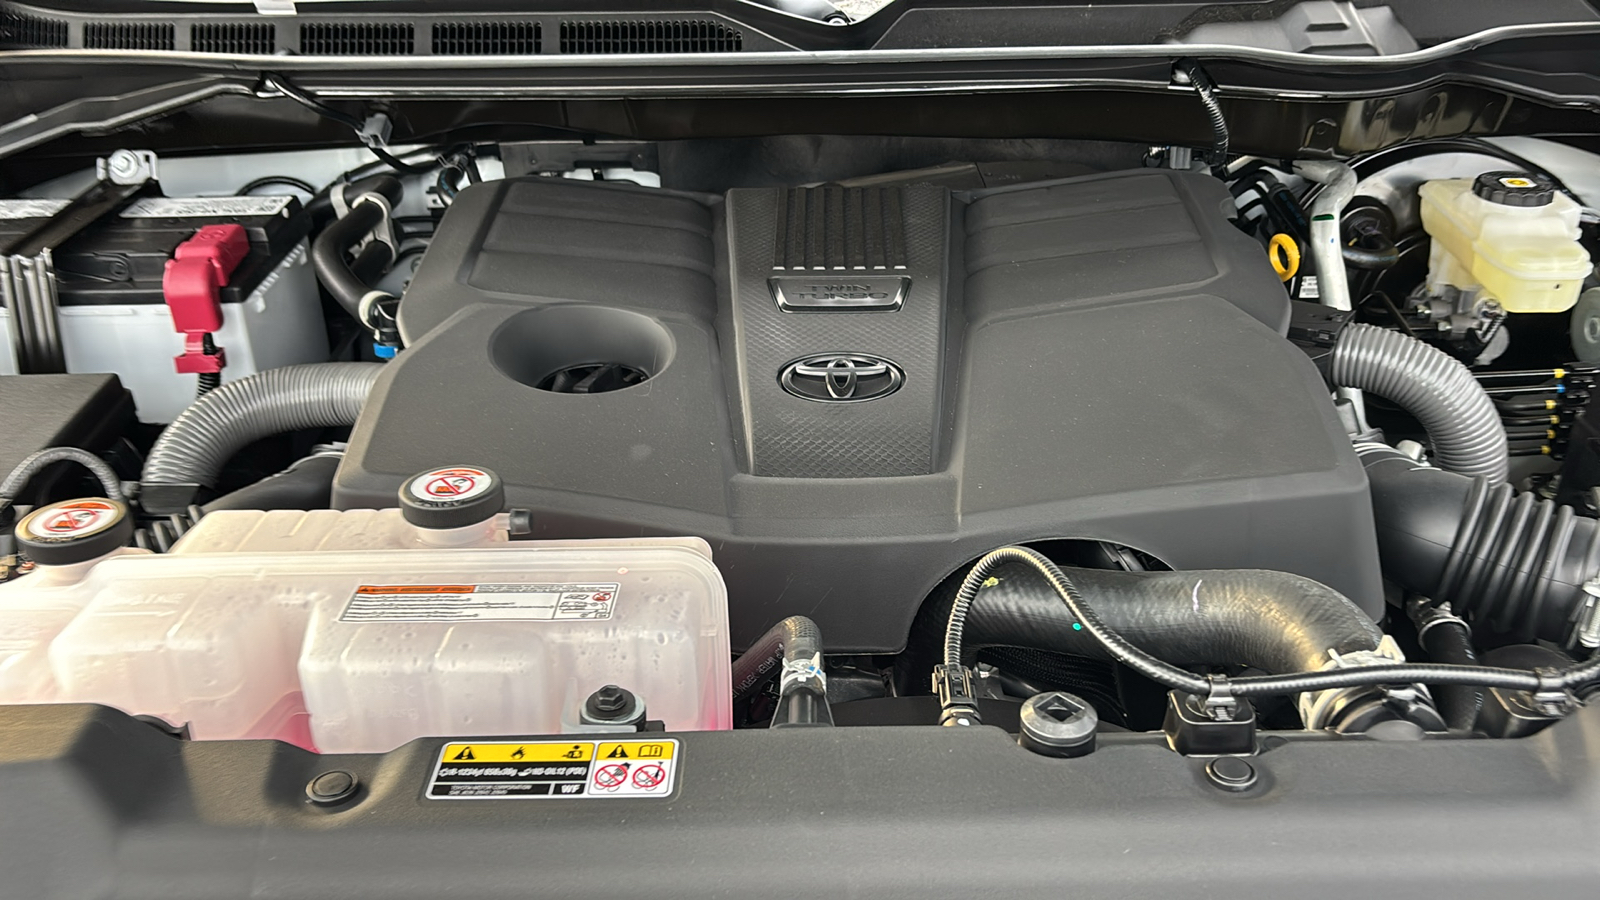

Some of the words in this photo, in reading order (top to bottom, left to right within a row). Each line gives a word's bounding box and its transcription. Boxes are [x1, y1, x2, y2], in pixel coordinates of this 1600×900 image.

[804, 284, 871, 292] TWIN
[792, 292, 889, 300] TURBO
[561, 784, 581, 794] WF
